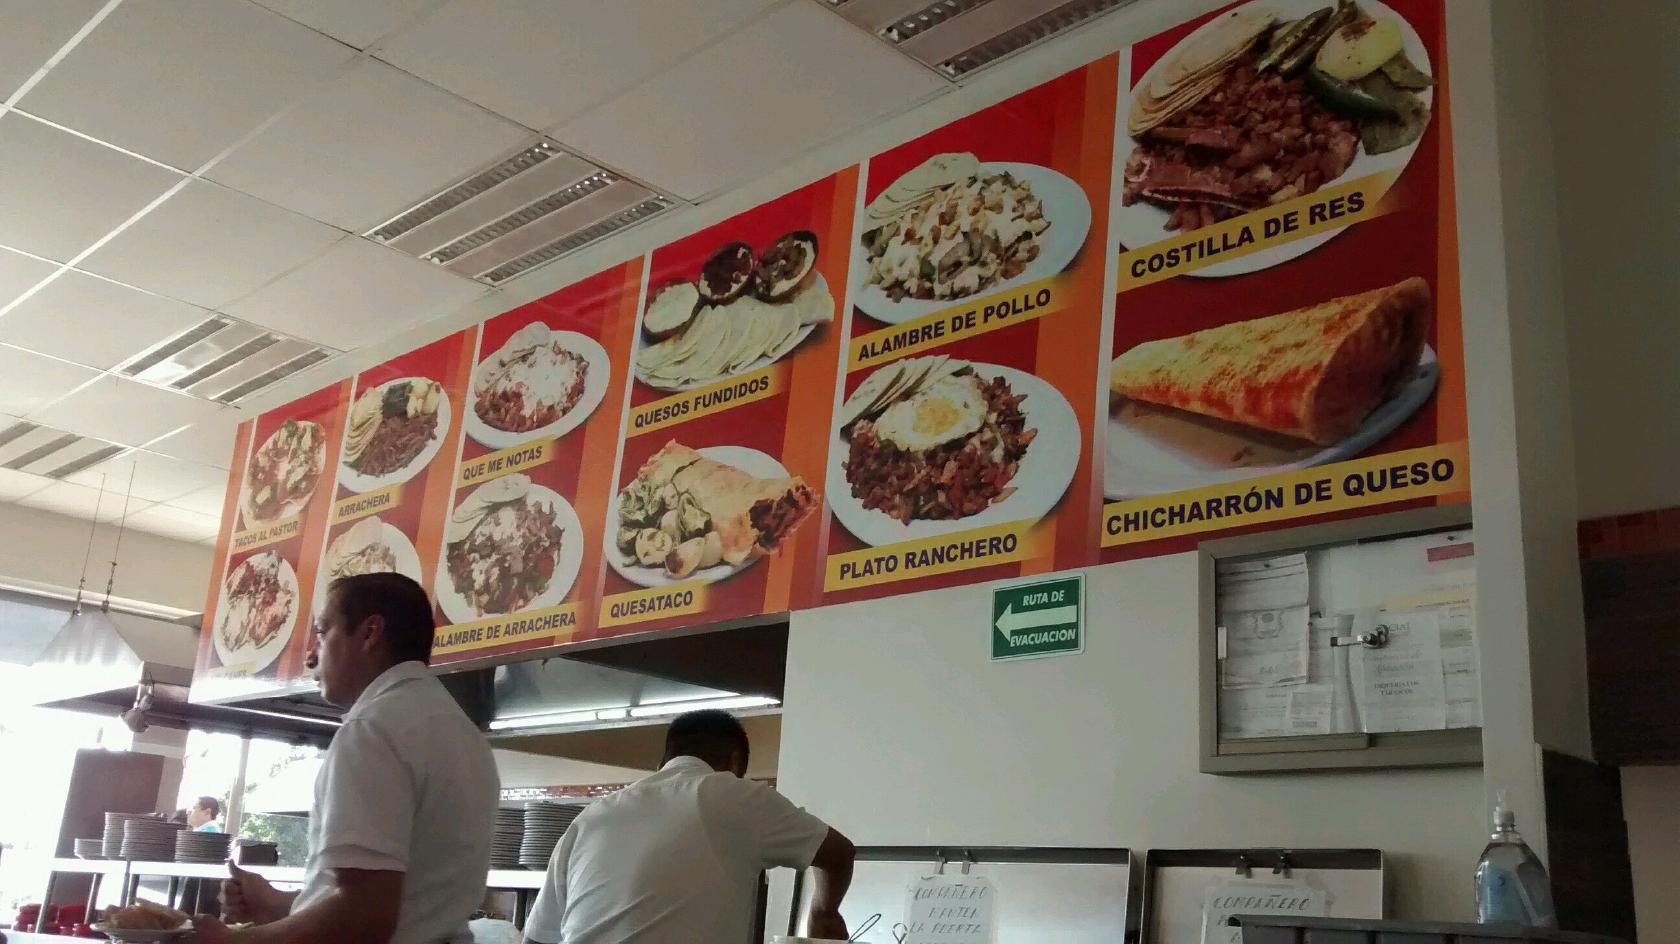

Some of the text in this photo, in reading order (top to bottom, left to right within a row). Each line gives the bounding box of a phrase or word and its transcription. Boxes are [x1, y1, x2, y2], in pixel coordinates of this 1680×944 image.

[1131, 191, 1365, 278] COSTILLA DE RES
[858, 288, 1051, 361] ALAMBRE DE POLLO
[634, 375, 769, 428] QUESOS FUNDIDOS
[463, 446, 543, 481] QUE ME NOTAS
[338, 493, 390, 516] ARRACHERA
[1106, 458, 1455, 536] CHICHARRÓN DE QUESO
[258, 530, 268, 541] AL
[270, 521, 298, 537] PASTOR
[839, 533, 1018, 581] PLATO RANCHERO
[610, 590, 693, 618] QUESATACO
[1023, 589, 1065, 606] RUTA DE
[433, 611, 577, 648] ALAMBRE DE ARRACHERA
[1010, 628, 1077, 647] EVACUACION
